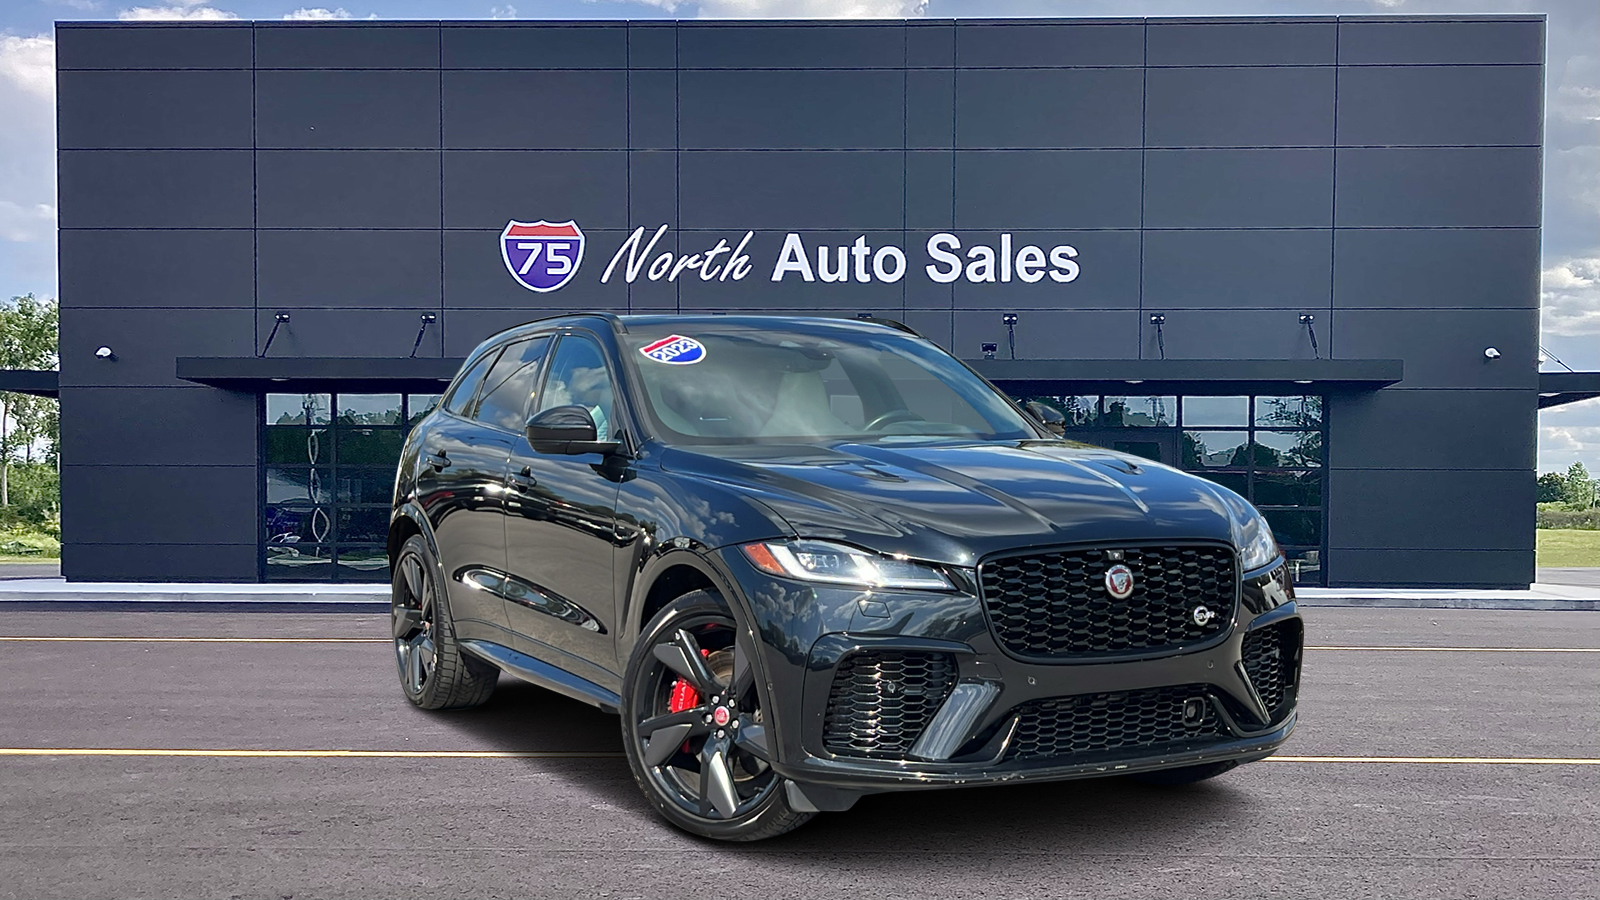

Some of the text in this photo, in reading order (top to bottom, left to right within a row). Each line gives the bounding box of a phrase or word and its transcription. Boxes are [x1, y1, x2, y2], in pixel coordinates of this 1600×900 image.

[516, 224, 1080, 284] 75 North Auto Sales
[653, 340, 698, 361] 2023
